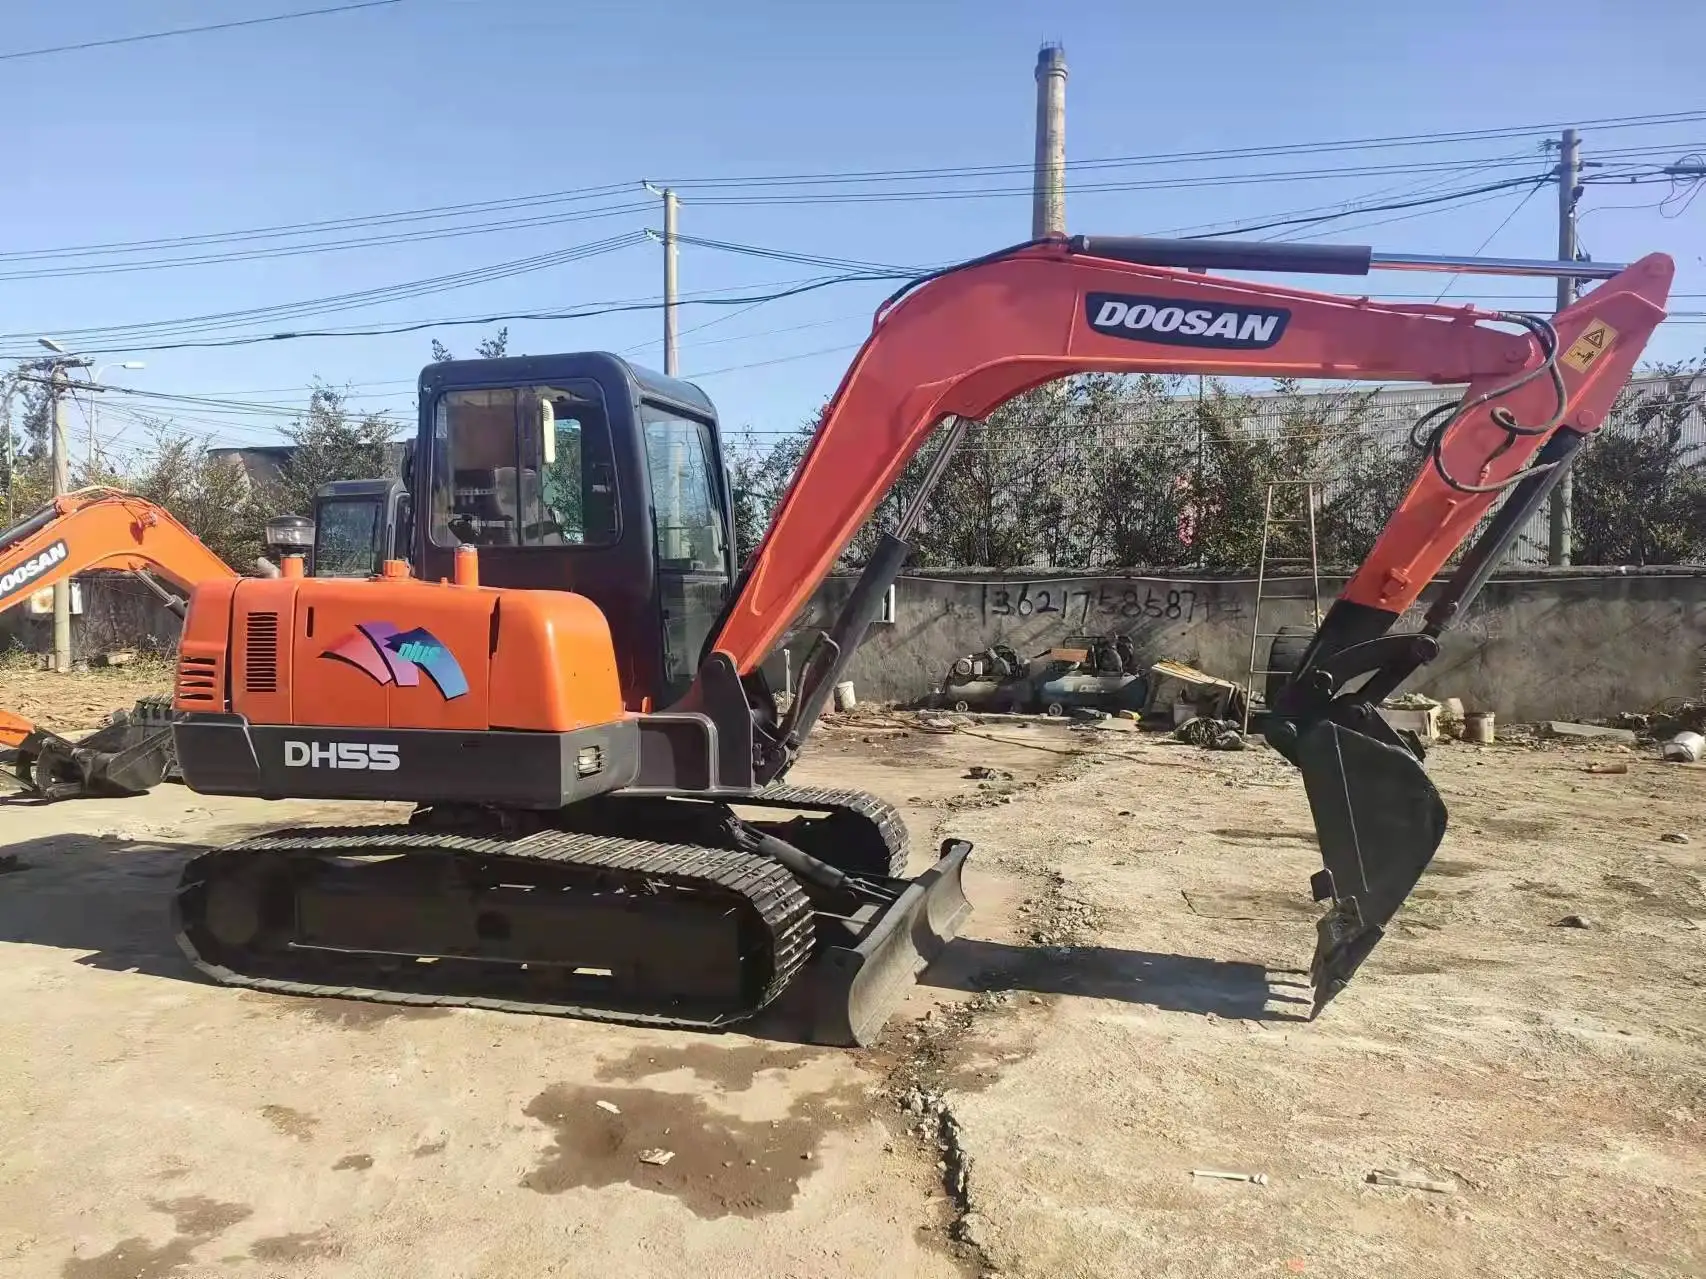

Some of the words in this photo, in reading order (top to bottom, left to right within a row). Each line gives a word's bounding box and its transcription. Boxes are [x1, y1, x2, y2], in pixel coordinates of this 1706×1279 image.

[1094, 301, 1279, 341] DOOSAN
[0, 543, 66, 596] OOSAN
[284, 741, 400, 771] DH55
